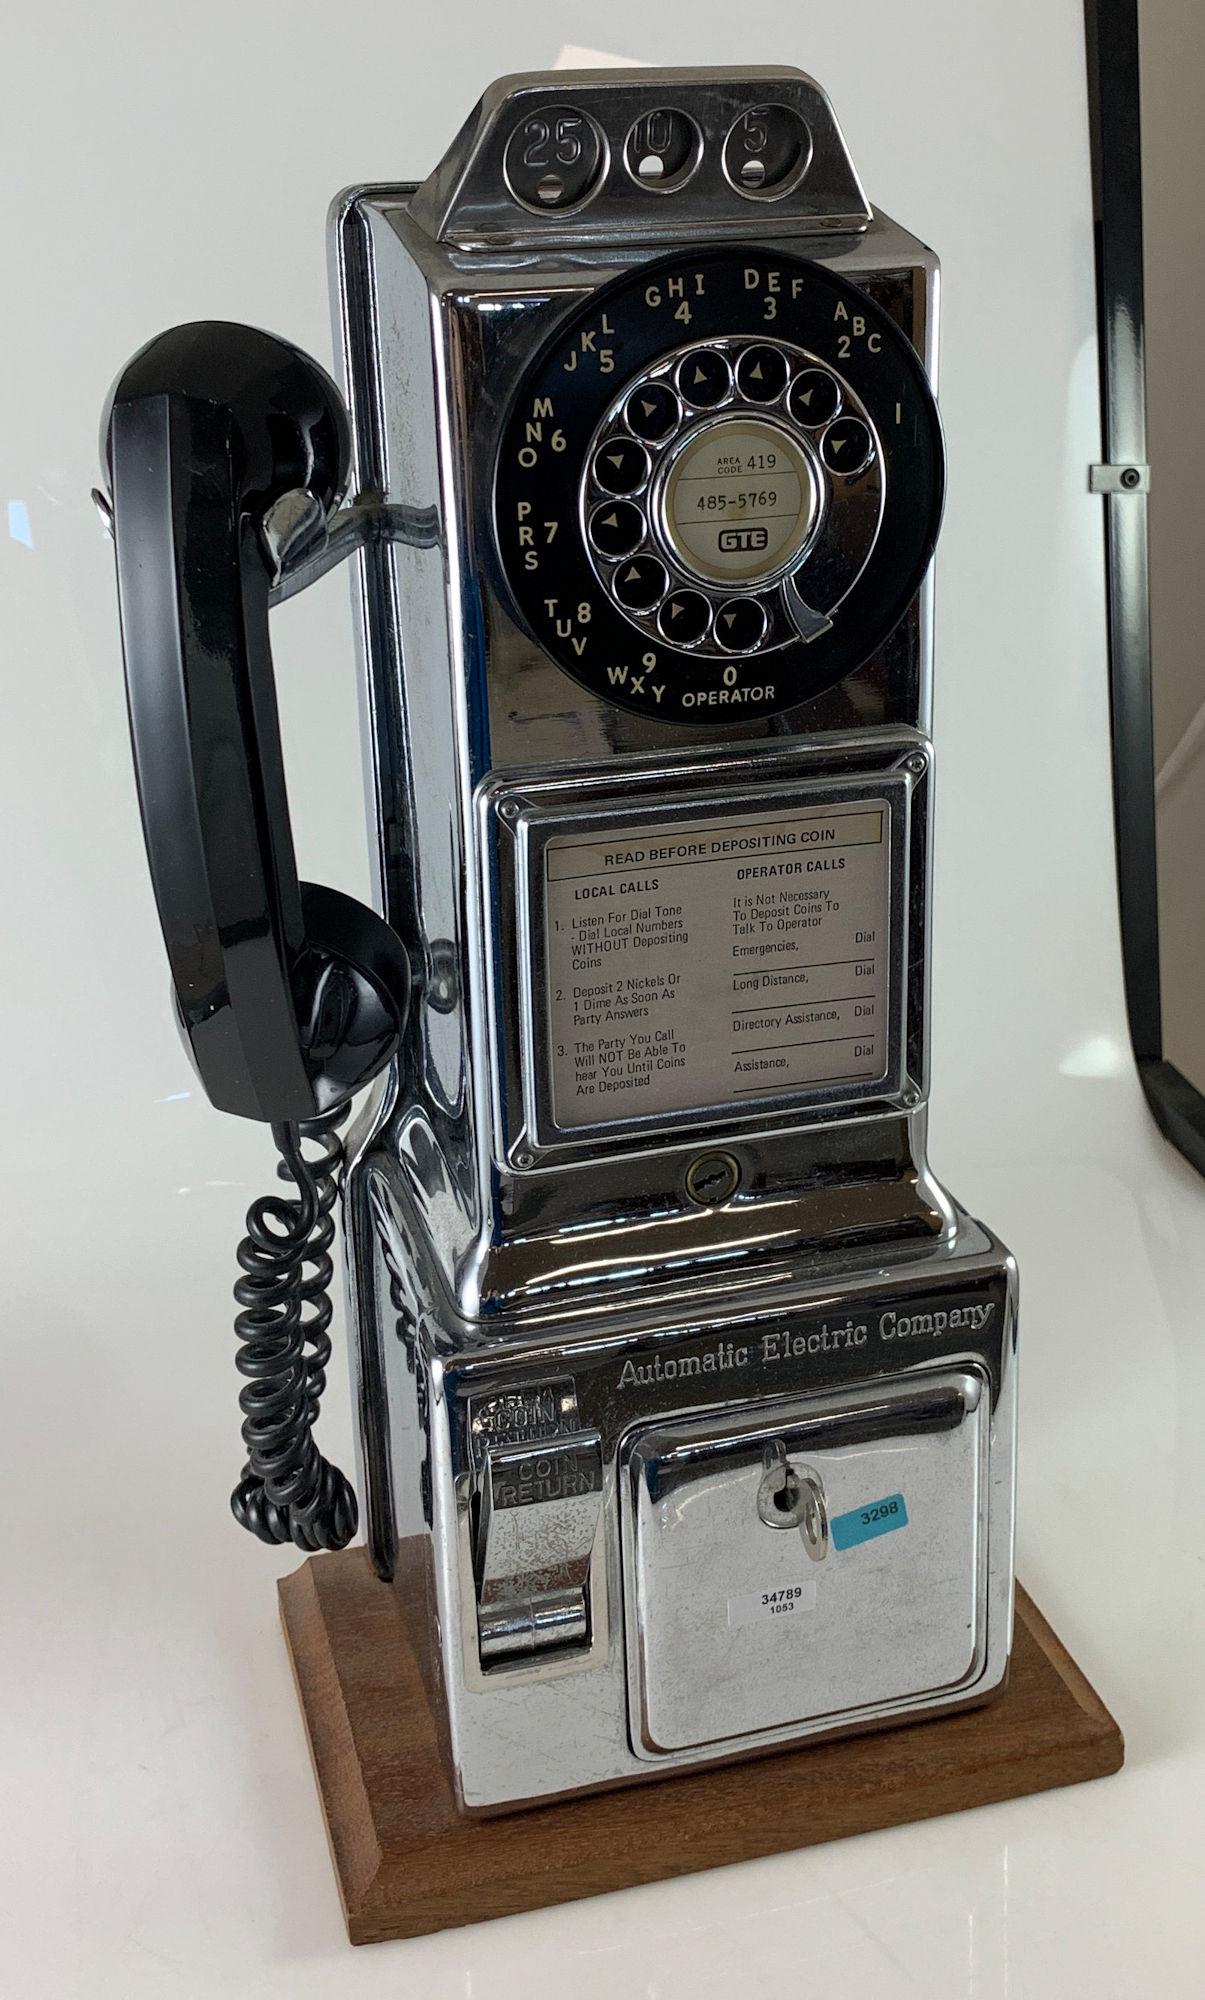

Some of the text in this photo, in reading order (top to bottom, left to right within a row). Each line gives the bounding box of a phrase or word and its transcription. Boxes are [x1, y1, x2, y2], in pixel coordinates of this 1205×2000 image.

[633, 110, 673, 154] 10
[743, 108, 769, 152] 5
[523, 118, 582, 167] 25
[674, 302, 692, 324] 4
[763, 297, 777, 320] 3
[838, 336, 851, 358] 2
[600, 350, 615, 373] 5
[551, 429, 567, 452] 6
[717, 454, 777, 469] AREA 419
[717, 465, 743, 475] CODE
[697, 491, 777, 511] 485-5769
[544, 522, 559, 543] 7
[719, 528, 767, 552] GTE
[576, 602, 592, 624] 8
[642, 653, 656, 674] 9
[682, 685, 775, 708] OPERATOR
[604, 829, 835, 866] READ BEFORE DEPOSITING COIN
[737, 858, 846, 880] OPERATOR CALLS
[575, 879, 660, 900] LOCAL CALLS
[733, 889, 830, 908] It is Not Necessary
[572, 915, 604, 929] Listen
[608, 912, 626, 924] For
[630, 908, 650, 920] Dial
[655, 906, 682, 917] Tone
[733, 900, 840, 922] To Deposit Coins To
[579, 929, 600, 942] Dial
[604, 925, 632, 938] Local
[636, 919, 684, 934] Numbers
[733, 917, 823, 935] Talk To Operator
[571, 932, 689, 956] WITHOUT Depositing
[732, 931, 875, 957] Emergencies, Dial
[572, 958, 602, 970] Coins
[573, 984, 613, 999] Deposit
[616, 981, 623, 992] 2
[627, 975, 665, 990] Nickels
[668, 973, 681, 984] Or
[733, 964, 875, 991] Long Distance, Dial
[574, 988, 675, 1012] 1 Dime As Soon As
[574, 1006, 649, 1026] Party Answers
[733, 1004, 875, 1032] Directory Assistance, Dial
[574, 1041, 594, 1053] The
[598, 1037, 626, 1051] Party
[630, 1034, 651, 1045] You
[655, 1029, 674, 1042] Call
[574, 1042, 686, 1068] Will NOT Be Able To
[734, 1045, 874, 1072] Assistance, Dial
[575, 1057, 686, 1082] hear You Until Coins
[576, 1074, 650, 1096] Are Deposited
[616, 1302, 995, 1390] Automatic Electric Company
[518, 1455, 578, 1481] COIN
[499, 1471, 596, 1507] RETURN
[861, 1501, 899, 1525] 3298
[761, 1587, 802, 1605] 34789
[770, 1602, 794, 1614] 1053
